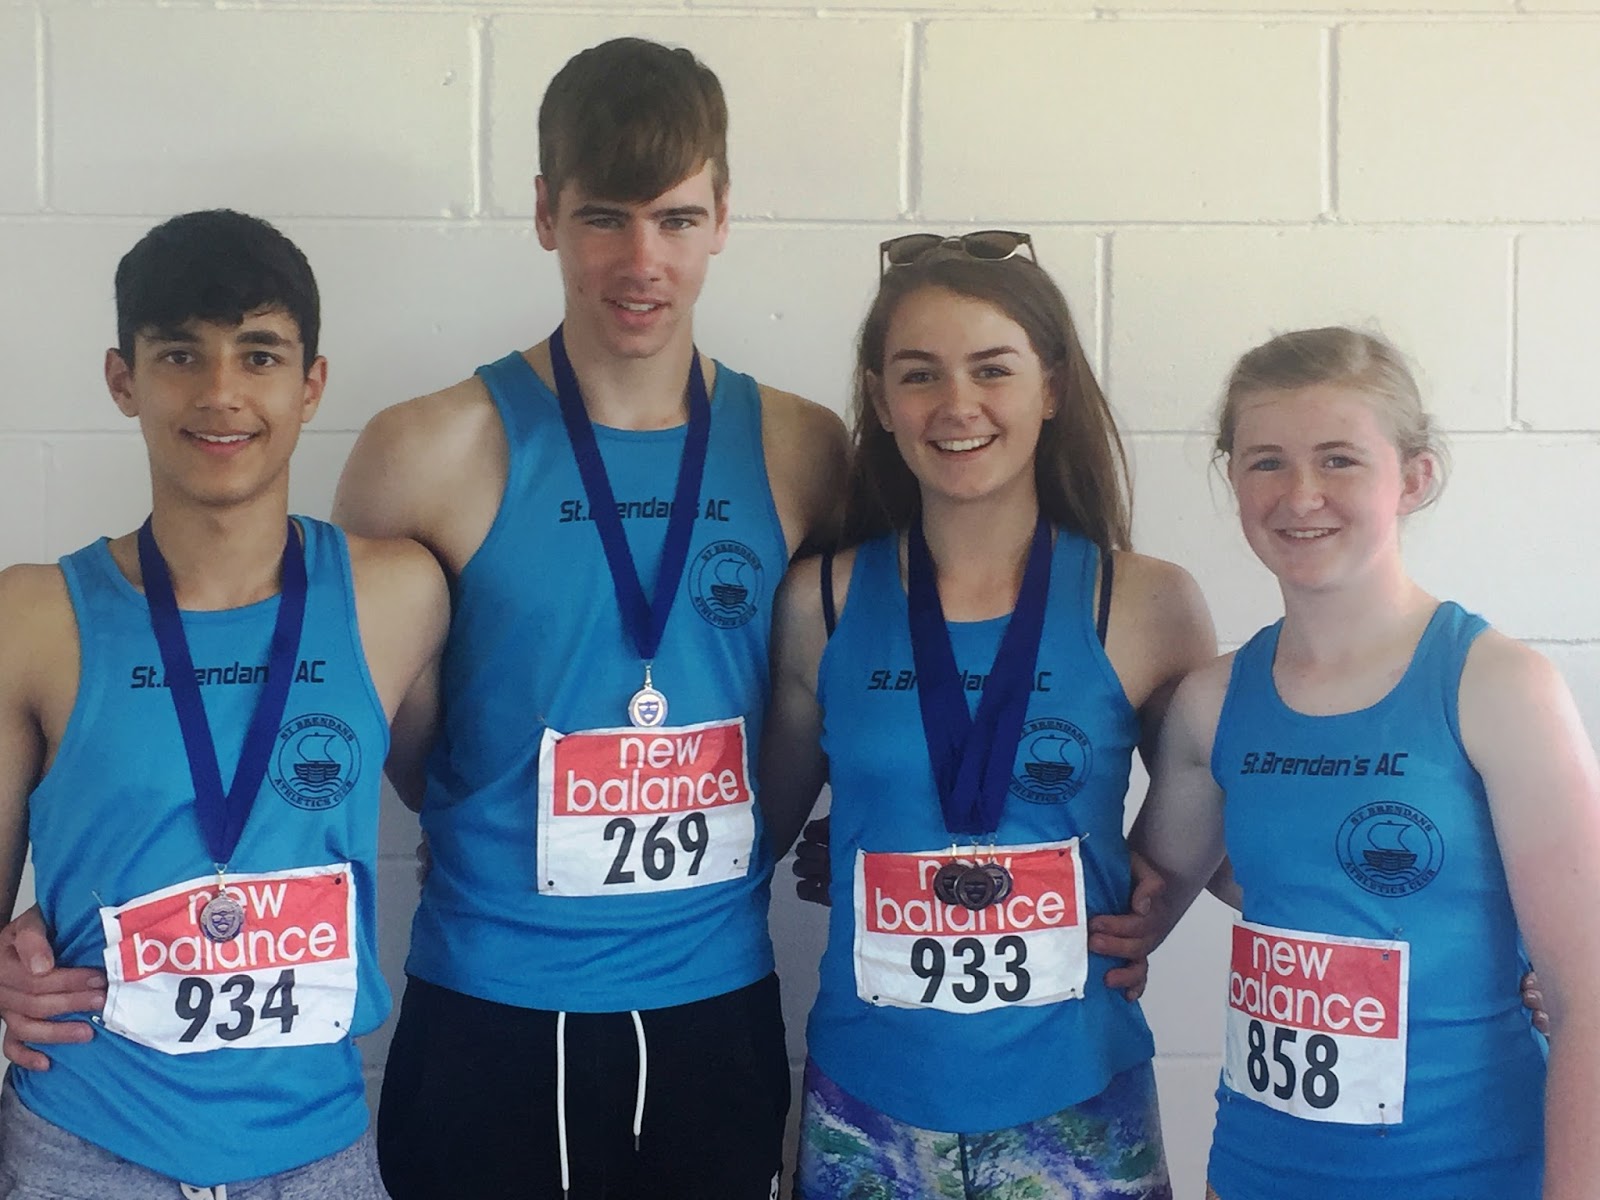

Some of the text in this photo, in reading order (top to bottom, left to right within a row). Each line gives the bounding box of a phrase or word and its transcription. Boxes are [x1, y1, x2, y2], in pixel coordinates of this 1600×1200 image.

[704, 498, 731, 521] AC
[131, 660, 326, 688] St.endan AC
[619, 734, 703, 769] new
[1240, 751, 1409, 777] St.Brendan's AC
[566, 769, 739, 813] balance
[1349, 804, 1434, 832] ST BRENDANS
[603, 812, 709, 885] 269
[1344, 862, 1406, 894] ATHLETICS
[875, 888, 1066, 933] balance
[133, 922, 338, 976] balance
[910, 935, 1031, 1004] 933
[1252, 936, 1333, 981] new
[175, 969, 299, 1042] 934
[1230, 971, 1386, 1033] balance
[1247, 1019, 1339, 1109] 858
